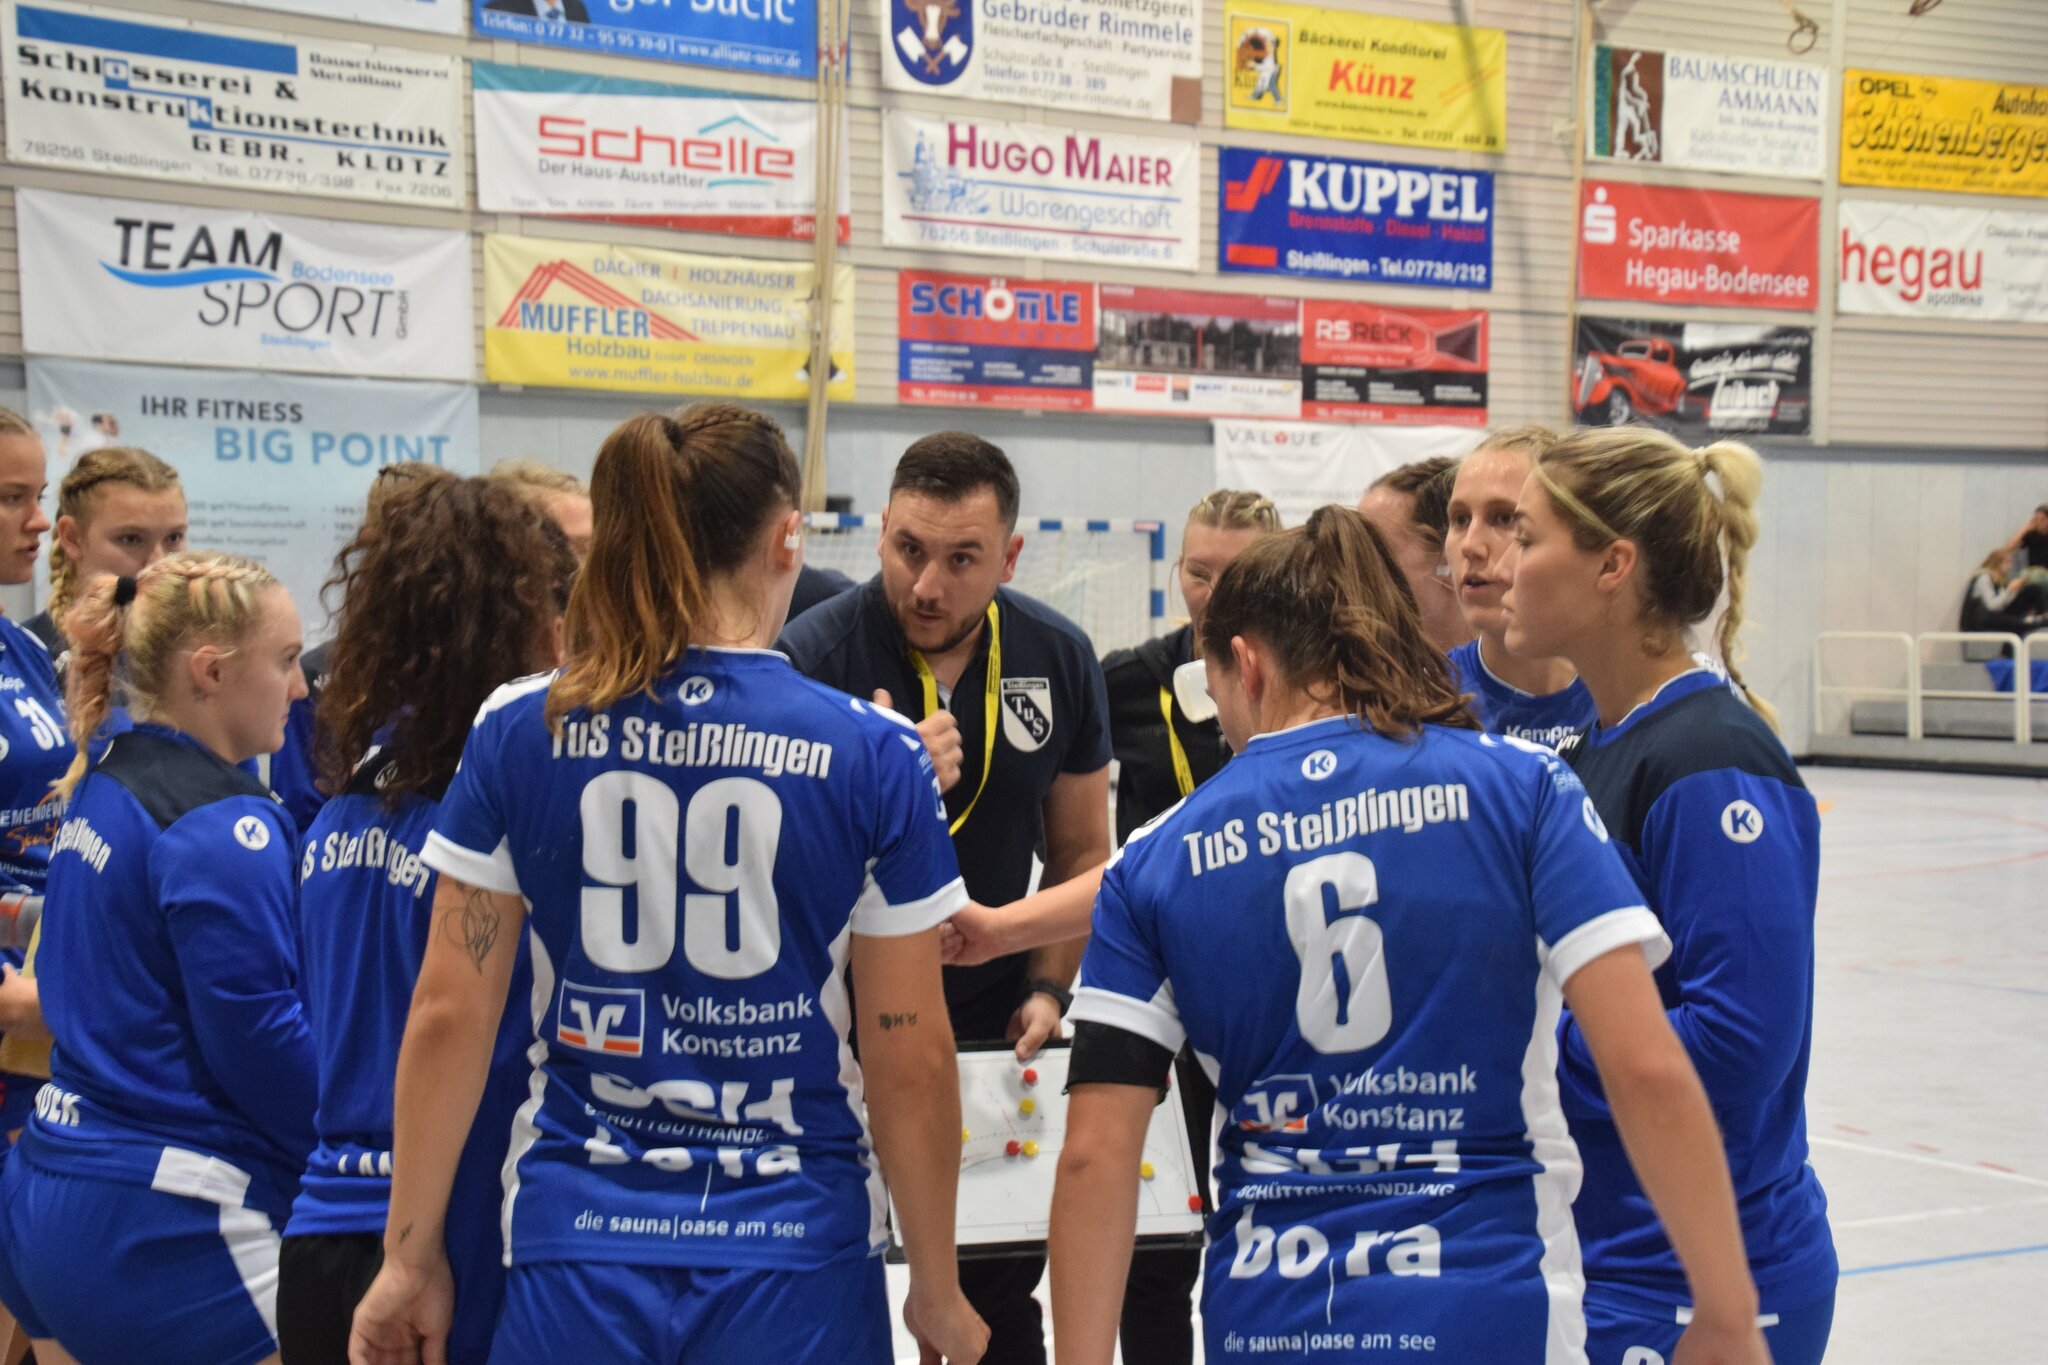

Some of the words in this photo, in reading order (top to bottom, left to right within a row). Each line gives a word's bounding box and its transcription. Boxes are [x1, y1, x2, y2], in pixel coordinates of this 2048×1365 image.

[481, 12, 532, 34] Telefon:
[1100, 11, 1193, 44] Rimmele
[1299, 29, 1365, 50] Bäckerei
[1370, 40, 1448, 60] Konditorei
[18, 45, 251, 96] Schlosserei
[275, 81, 298, 99] &
[1329, 58, 1416, 100] Künz
[1670, 55, 1820, 92] BAUMSCHULEN
[1859, 77, 1915, 98] OPEL
[20, 77, 447, 148] Konstruktionstechnik
[1718, 86, 1819, 116] AMMANN
[192, 136, 304, 164] GEBR.
[337, 150, 448, 177] KLOTZ
[539, 115, 794, 179] Schelle
[539, 158, 567, 176] Der
[573, 162, 705, 188] Haus-Ausstatter
[1289, 158, 1488, 222] KUPPEL
[1000, 190, 1173, 231] Warengeschäft
[114, 217, 283, 271] TEAM
[975, 230, 1060, 252] Steißlingen
[1628, 216, 1741, 254] Sparkasse
[291, 260, 395, 286] Bodensee
[594, 257, 661, 280] DÄCHER
[689, 267, 797, 290] HOLZHÄUSER
[1287, 249, 1370, 276] Steißlingen
[1625, 257, 1810, 298] Hegau-Bodensee
[1840, 227, 1984, 303] hegau
[199, 280, 396, 339] SPORT
[641, 288, 783, 315] DACHSANIERUNG
[911, 277, 1081, 325] SCHÖTTLE
[519, 302, 650, 339] MUFFLER
[691, 317, 797, 340] TREPPENBAU
[567, 338, 651, 361] Holzbau
[141, 395, 188, 417] IHR
[198, 398, 304, 424] FITNESS
[215, 427, 294, 465] BIG
[311, 431, 451, 467] POINT
[552, 715, 609, 760] TuS
[621, 716, 833, 780] Steißlingen
[1183, 818, 1248, 877] TuS
[1256, 783, 1469, 857] Steißlingen
[580, 770, 783, 980] 99
[1283, 851, 1393, 1055] 6
[661, 993, 813, 1028] Volksbank
[661, 1028, 802, 1058] Konstanz
[1322, 1103, 1465, 1131] Konstanz
[575, 1209, 602, 1231] die
[735, 1217, 766, 1236] am
[772, 1218, 805, 1239] see
[1224, 1332, 1244, 1353] die
[1361, 1332, 1391, 1351] am
[1399, 1332, 1436, 1351] see
